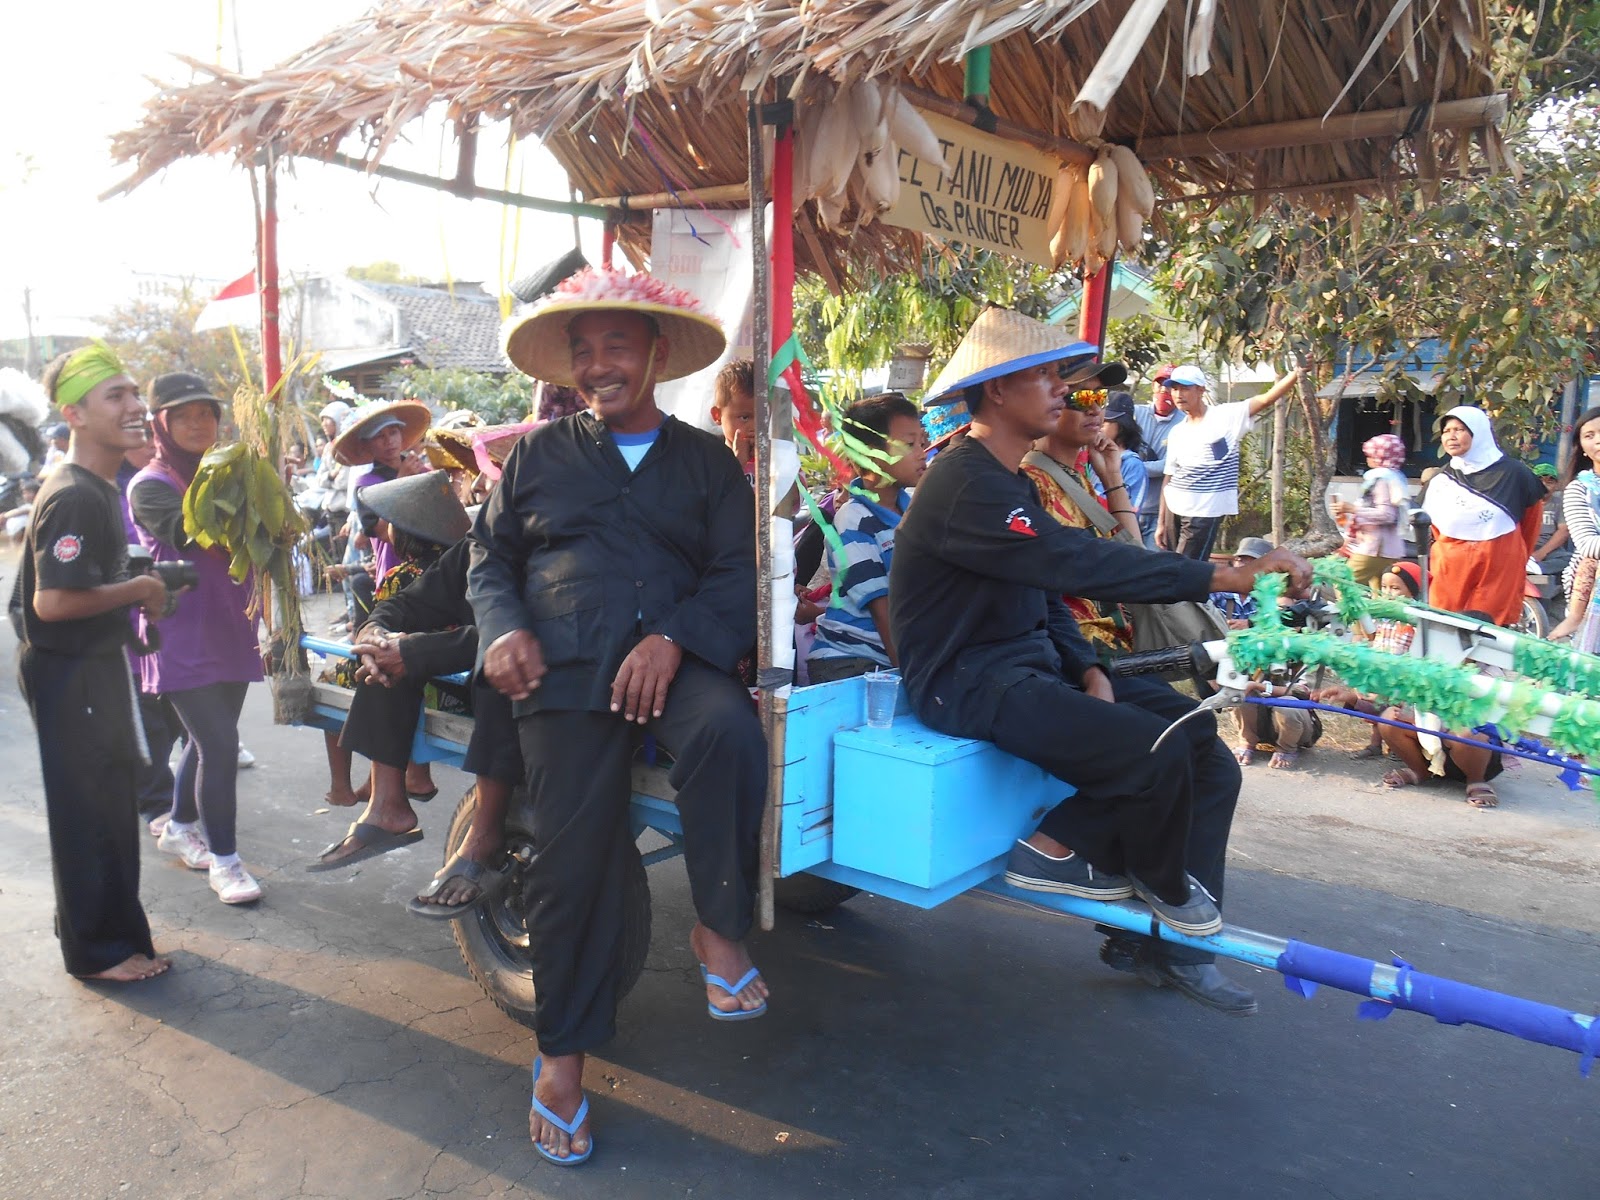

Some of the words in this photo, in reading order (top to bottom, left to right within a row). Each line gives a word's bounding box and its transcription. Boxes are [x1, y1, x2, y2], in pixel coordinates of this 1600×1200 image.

[937, 139, 992, 204] TANI
[992, 162, 1053, 220] MULYA
[954, 200, 1023, 250] PANJER
